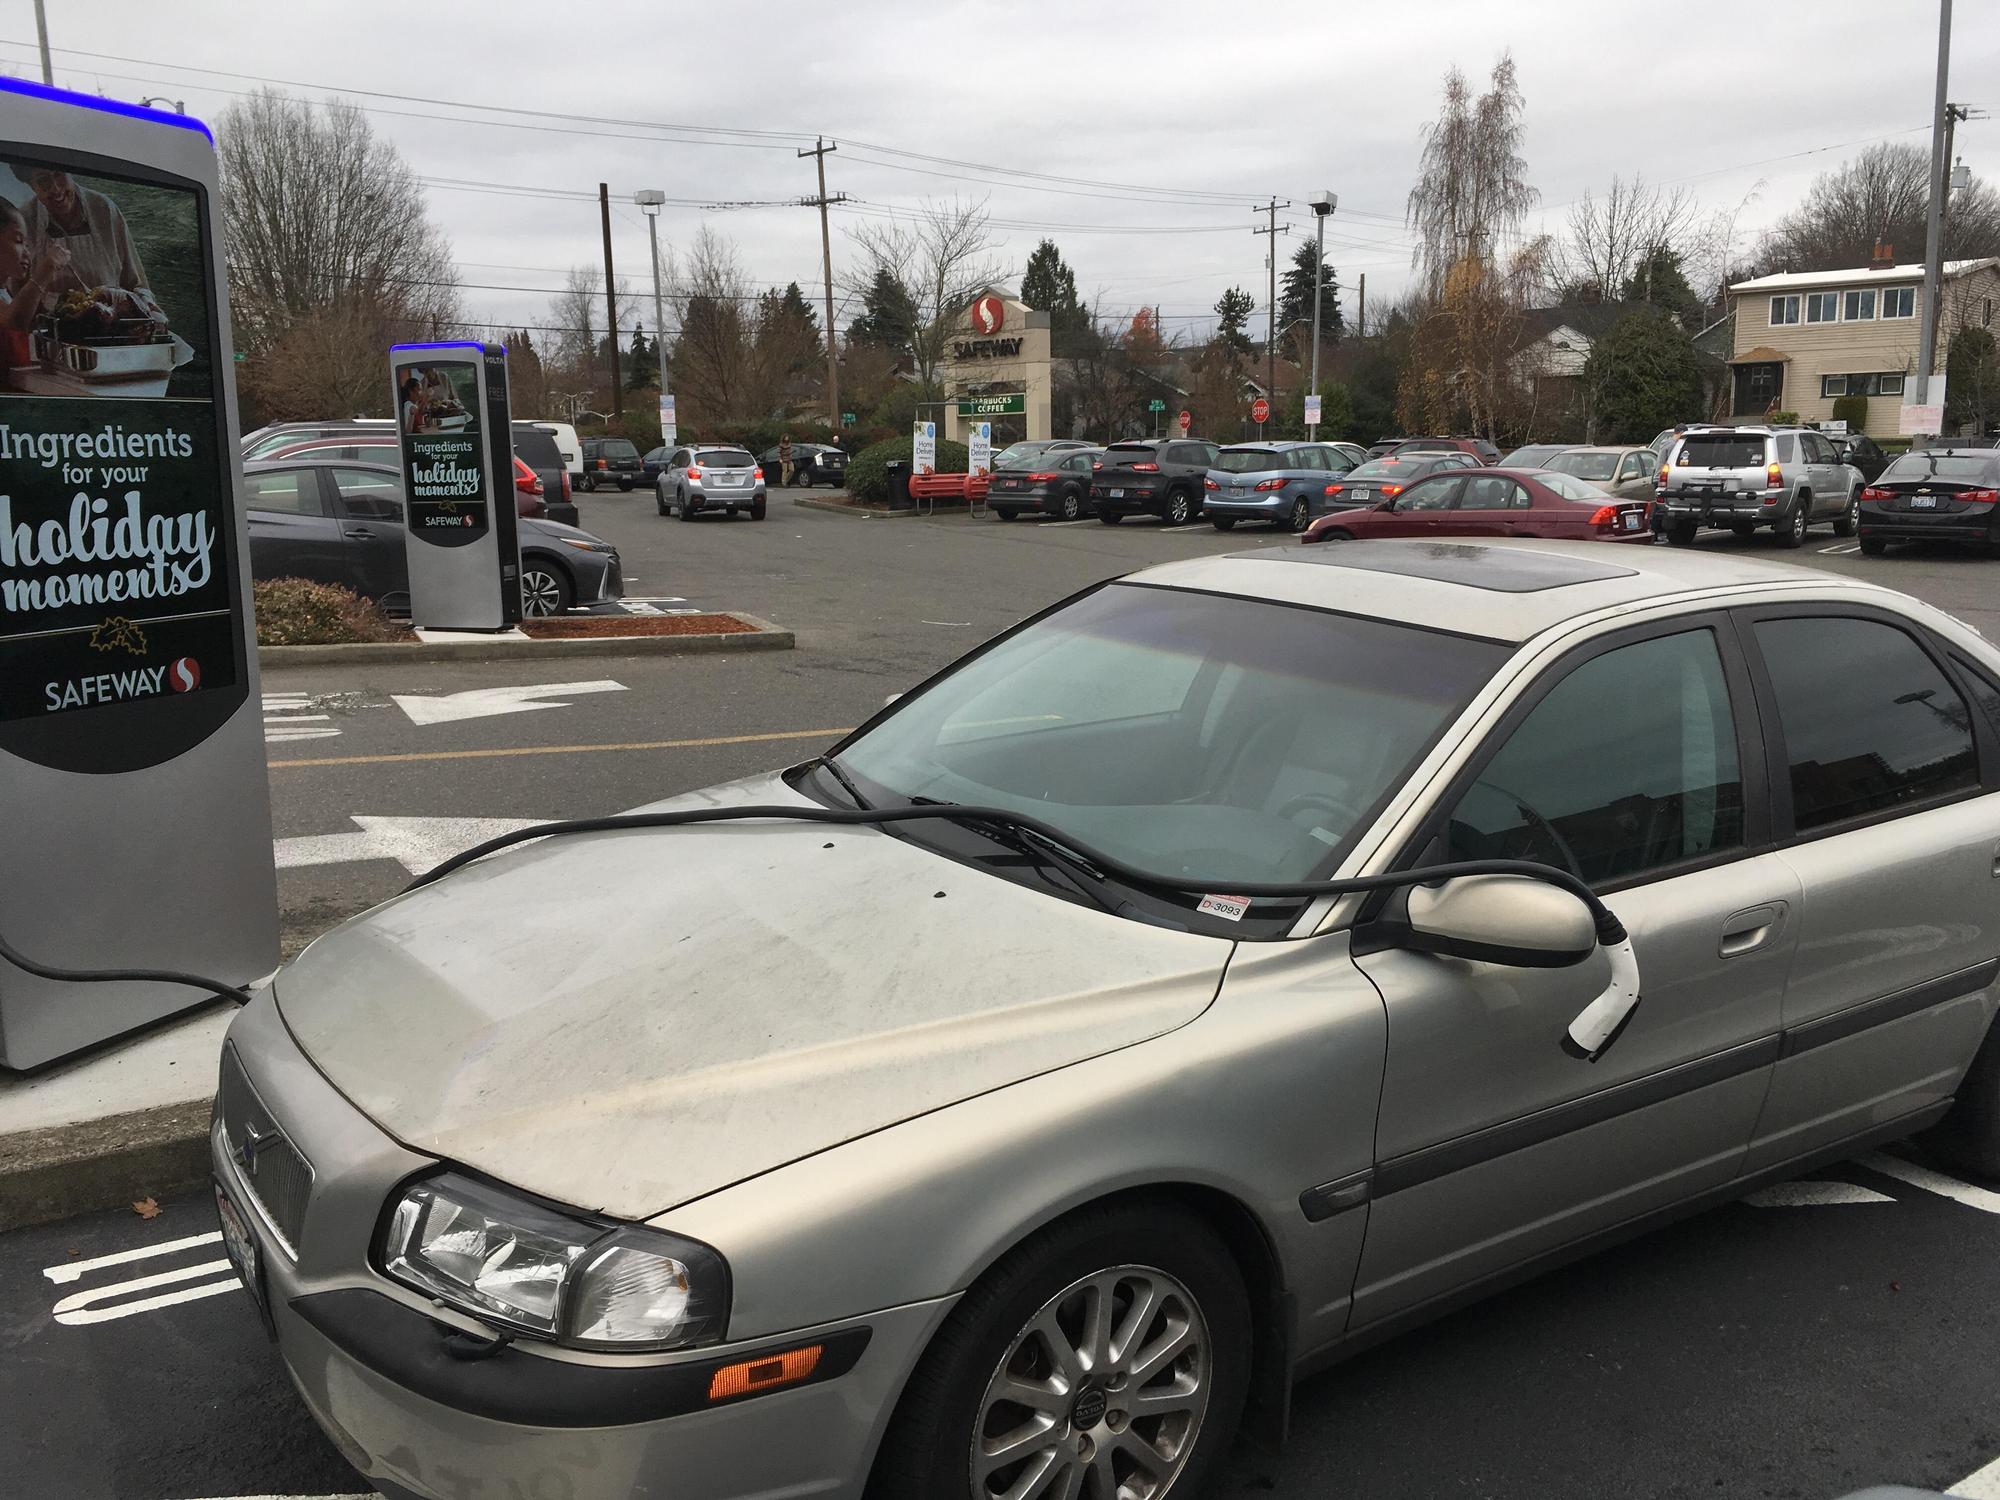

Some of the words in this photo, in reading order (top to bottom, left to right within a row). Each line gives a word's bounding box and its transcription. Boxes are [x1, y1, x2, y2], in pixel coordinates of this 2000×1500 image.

[977, 404, 1004, 413] COFFEE
[1253, 406, 1267, 415] STOP
[0, 424, 193, 468] Ingredients
[413, 441, 473, 455] Ingredients
[442, 454, 458, 462] your
[62, 463, 93, 484] for
[102, 465, 149, 489] your
[412, 461, 480, 494] holiday
[414, 480, 470, 496] moments
[425, 516, 462, 526] SAFEWAY
[0, 490, 215, 588] holiday
[1, 555, 189, 612] moments
[45, 666, 166, 711] SAFEWAY
[1202, 900, 1241, 915] D-3093
[1075, 1403, 1105, 1417] VOLVO
